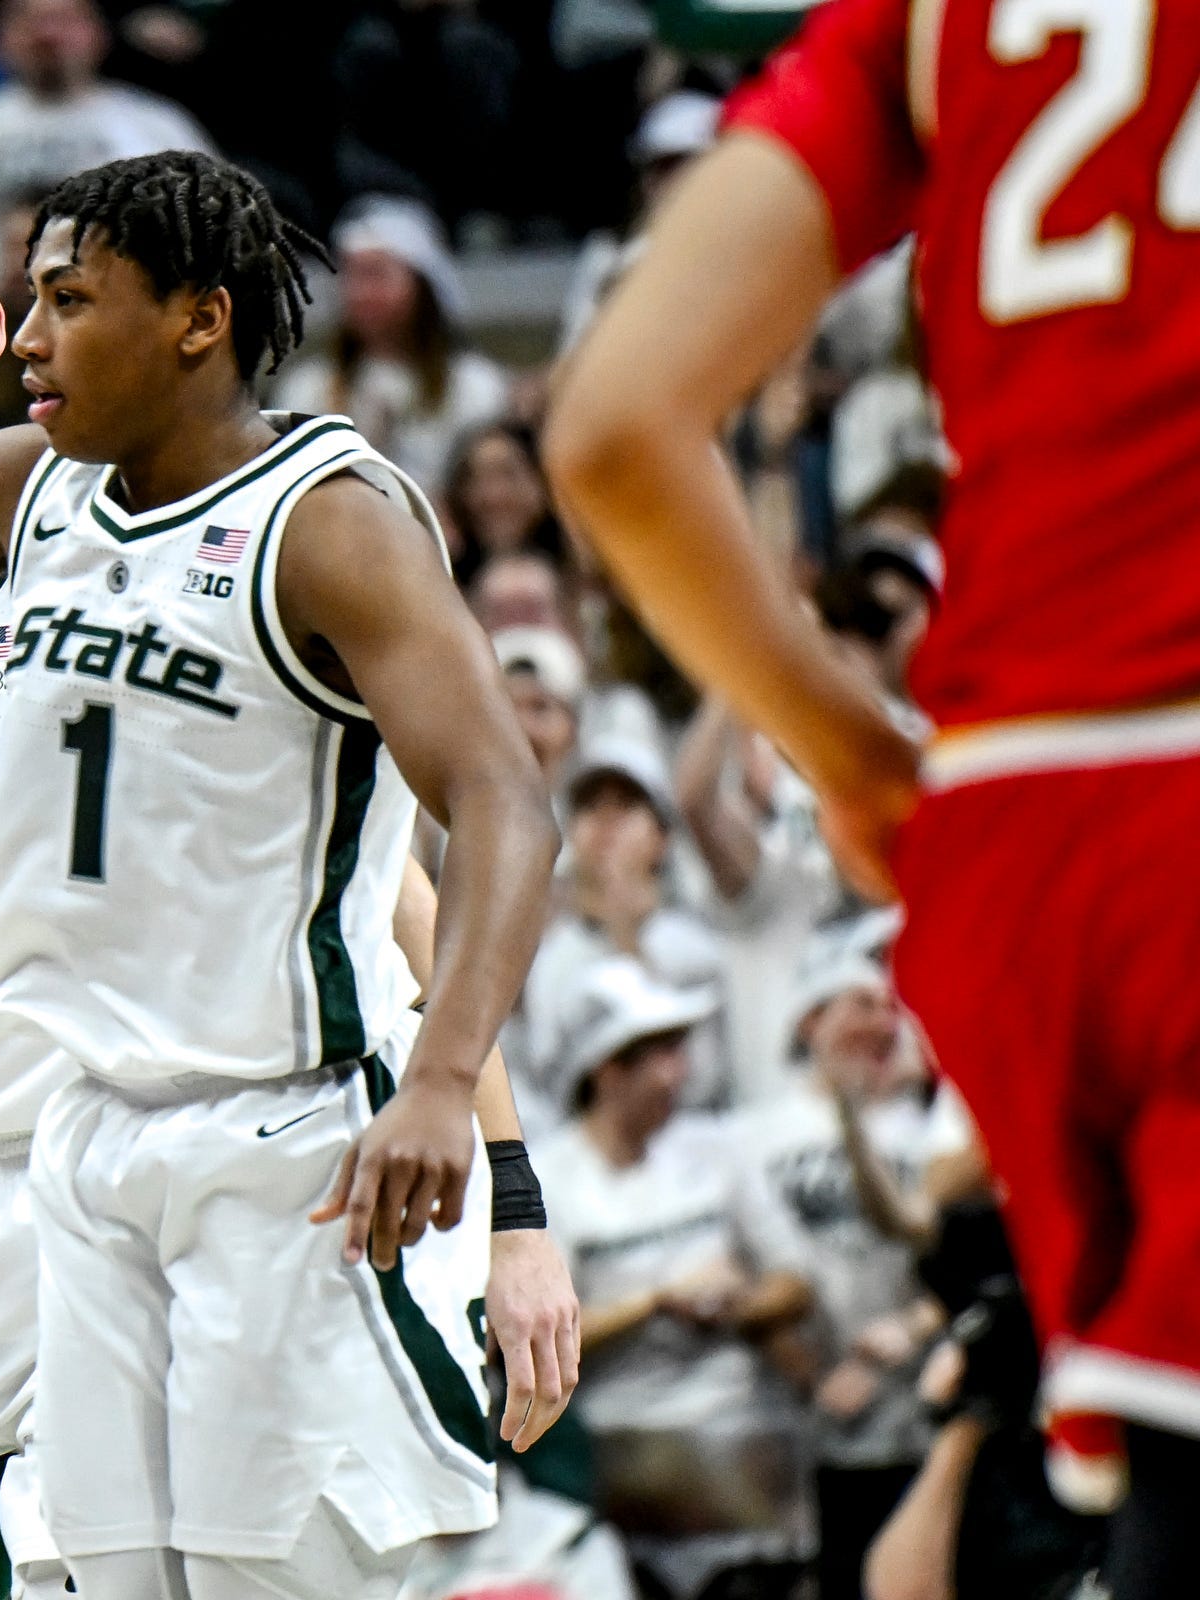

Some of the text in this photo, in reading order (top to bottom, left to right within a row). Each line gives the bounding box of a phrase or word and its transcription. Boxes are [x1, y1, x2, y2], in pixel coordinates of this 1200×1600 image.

[977, 0, 1200, 327] 2
[5, 606, 241, 720] State
[60, 699, 116, 885] 1
